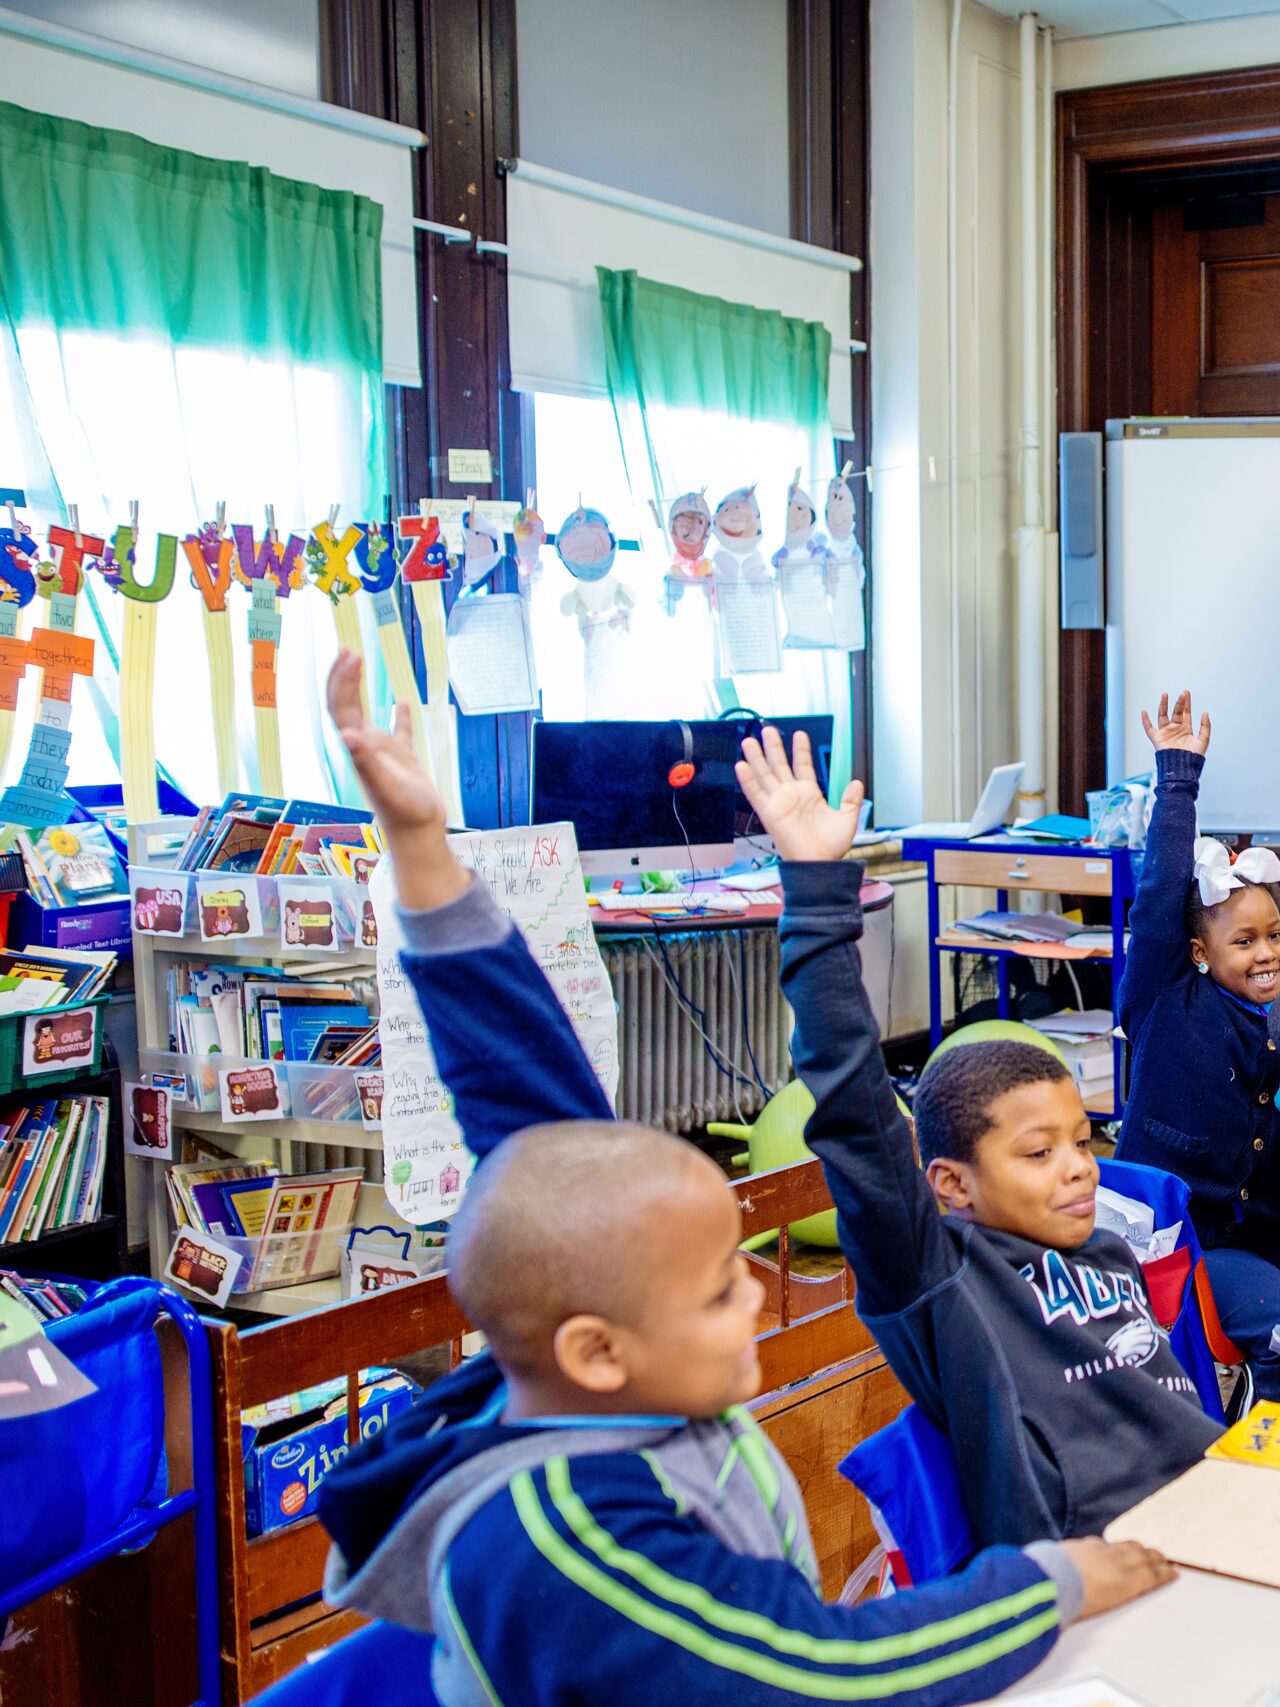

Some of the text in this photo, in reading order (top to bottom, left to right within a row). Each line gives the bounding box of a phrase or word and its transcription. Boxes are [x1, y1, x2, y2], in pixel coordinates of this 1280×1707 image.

[47, 524, 105, 597] T
[114, 524, 178, 602] U
[180, 537, 236, 612] V
[231, 522, 307, 599] W
[311, 520, 366, 597] X
[399, 515, 446, 584] Z
[33, 642, 92, 668] together
[42, 678, 70, 698] the
[44, 710, 62, 728] to
[32, 731, 69, 767] they
[25, 767, 64, 794] today
[6, 800, 66, 825] omorrow
[531, 835, 561, 868] ASK
[155, 890, 182, 906] USA
[221, 979, 239, 991] HOW
[387, 1015, 410, 1032] Who
[60, 1029, 82, 1044] OUR
[405, 1031, 425, 1045] this
[391, 1071, 418, 1092] Why
[393, 1143, 419, 1161] What
[200, 1250, 227, 1270] BLACK
